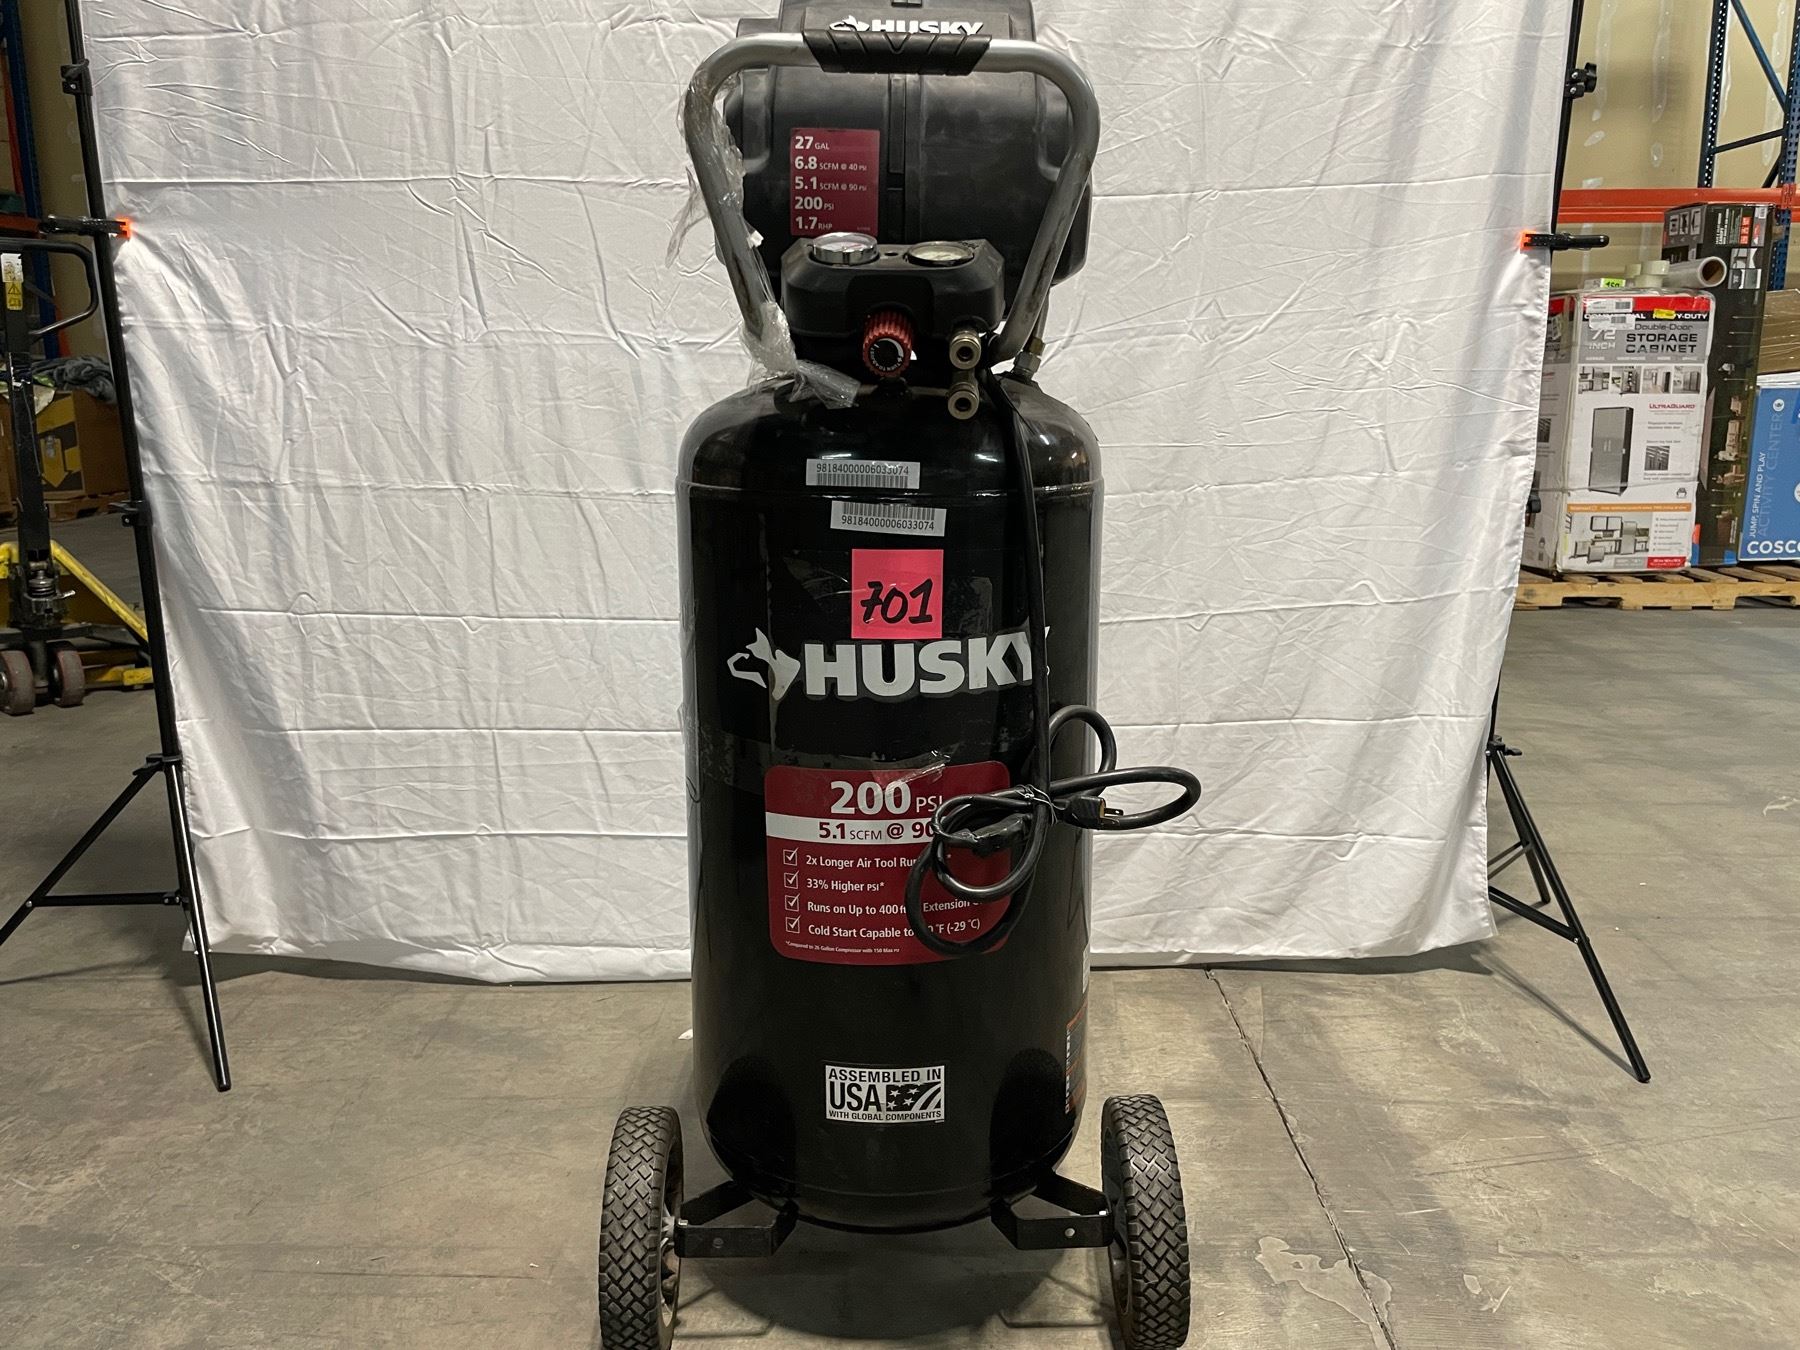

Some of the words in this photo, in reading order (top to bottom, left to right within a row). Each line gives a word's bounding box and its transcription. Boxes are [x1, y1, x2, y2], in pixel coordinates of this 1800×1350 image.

[871, 19, 984, 36] HUSKY
[794, 136, 814, 150] 27
[794, 156, 817, 170] 6.8
[794, 176, 817, 190] 5.1
[820, 183, 839, 191] SCFM
[794, 196, 823, 210] 200
[795, 216, 818, 229] 1.7
[1634, 323, 1693, 331] Double-Door
[1626, 333, 1698, 342] STORAGE
[1625, 344, 1697, 354] CABINET
[816, 463, 909, 475] 98184000006033074
[1757, 451, 1767, 472] PLAY
[1755, 473, 1764, 493] AND
[1752, 494, 1761, 514] SPIN
[841, 515, 935, 531] 98184000006033074
[1749, 515, 1759, 538] JUMP,
[1747, 540, 1800, 554] COSC
[860, 578, 933, 624] 701
[804, 628, 1048, 697] HUSKY
[830, 780, 911, 815] 200
[819, 821, 845, 839] 5.1
[849, 830, 882, 840] SCFM
[886, 823, 904, 839] @
[806, 855, 817, 865] 2x
[820, 856, 854, 869] Longer
[857, 858, 872, 868] Air
[874, 857, 897, 868] Tool
[806, 878, 828, 890] 33%
[831, 881, 864, 893] Higher
[807, 901, 831, 913] Runs
[833, 905, 846, 914] on
[848, 904, 863, 917] Up
[866, 905, 876, 915] to
[879, 904, 898, 915] 400
[808, 924, 830, 936] Cold
[832, 926, 857, 937] Start
[860, 928, 901, 940] Capable
[904, 928, 914, 937] to
[947, 920, 966, 934] (-29
[829, 1068, 920, 1083] ASSEMBLED
[927, 1068, 941, 1080] IN
[830, 1081, 882, 1112] USA
[829, 1110, 849, 1119] WITH
[851, 1112, 884, 1121] GLOBAL
[886, 1111, 941, 1121] COMPONENTS
